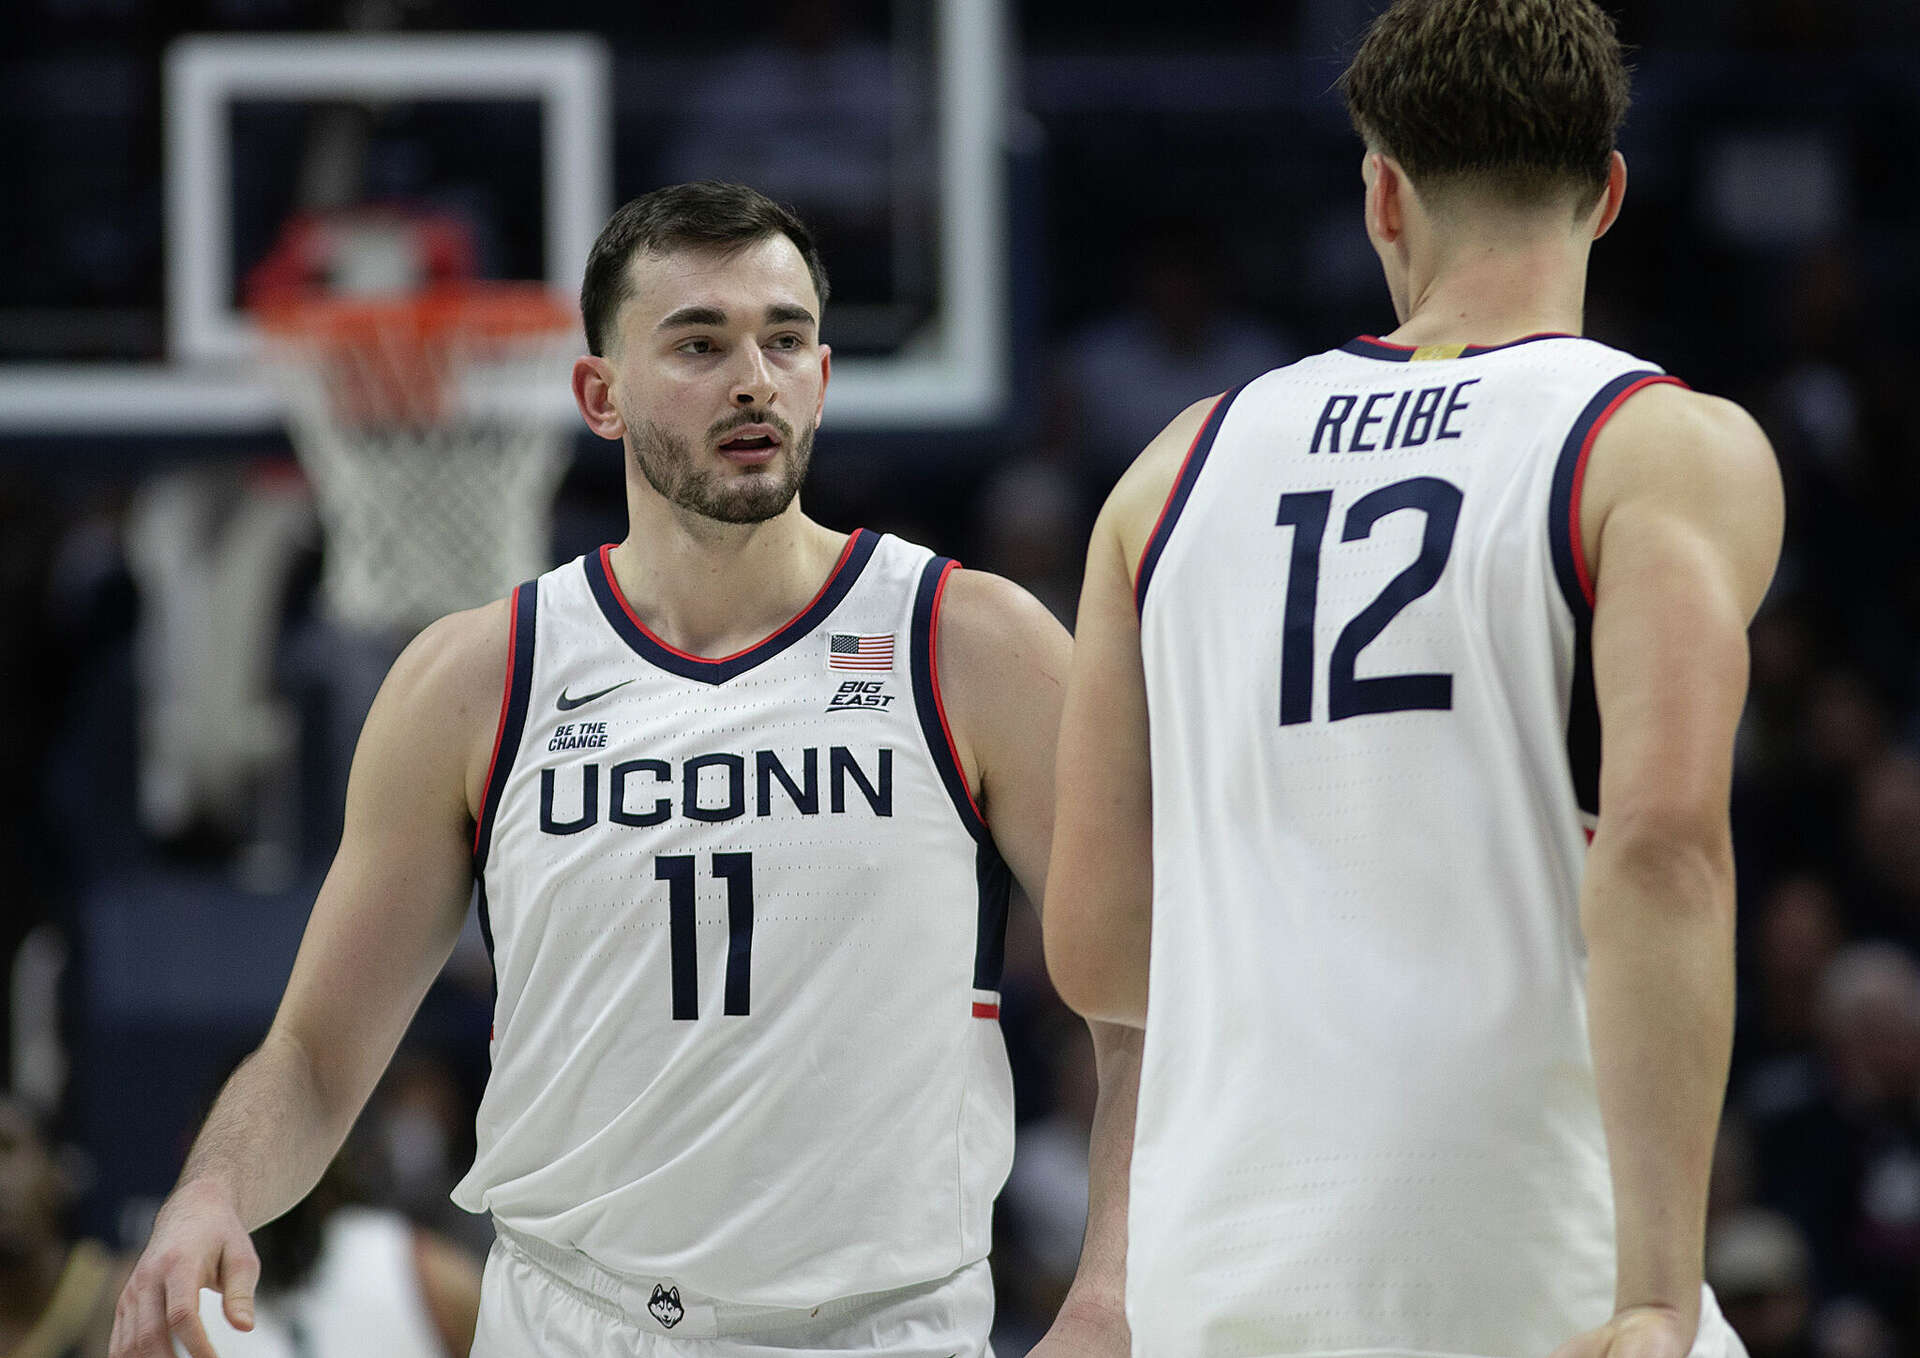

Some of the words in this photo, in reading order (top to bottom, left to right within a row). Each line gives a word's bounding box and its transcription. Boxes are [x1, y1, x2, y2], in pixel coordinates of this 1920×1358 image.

[1309, 378, 1482, 454] REIBE
[1275, 476, 1464, 726] 12
[829, 694, 895, 707] EAST
[839, 681, 885, 694] BIG
[548, 735, 608, 752] CHANGE
[555, 724, 576, 737] BE
[579, 722, 607, 735] THE
[540, 747, 893, 836] UCONN
[655, 852, 755, 1021] 11
